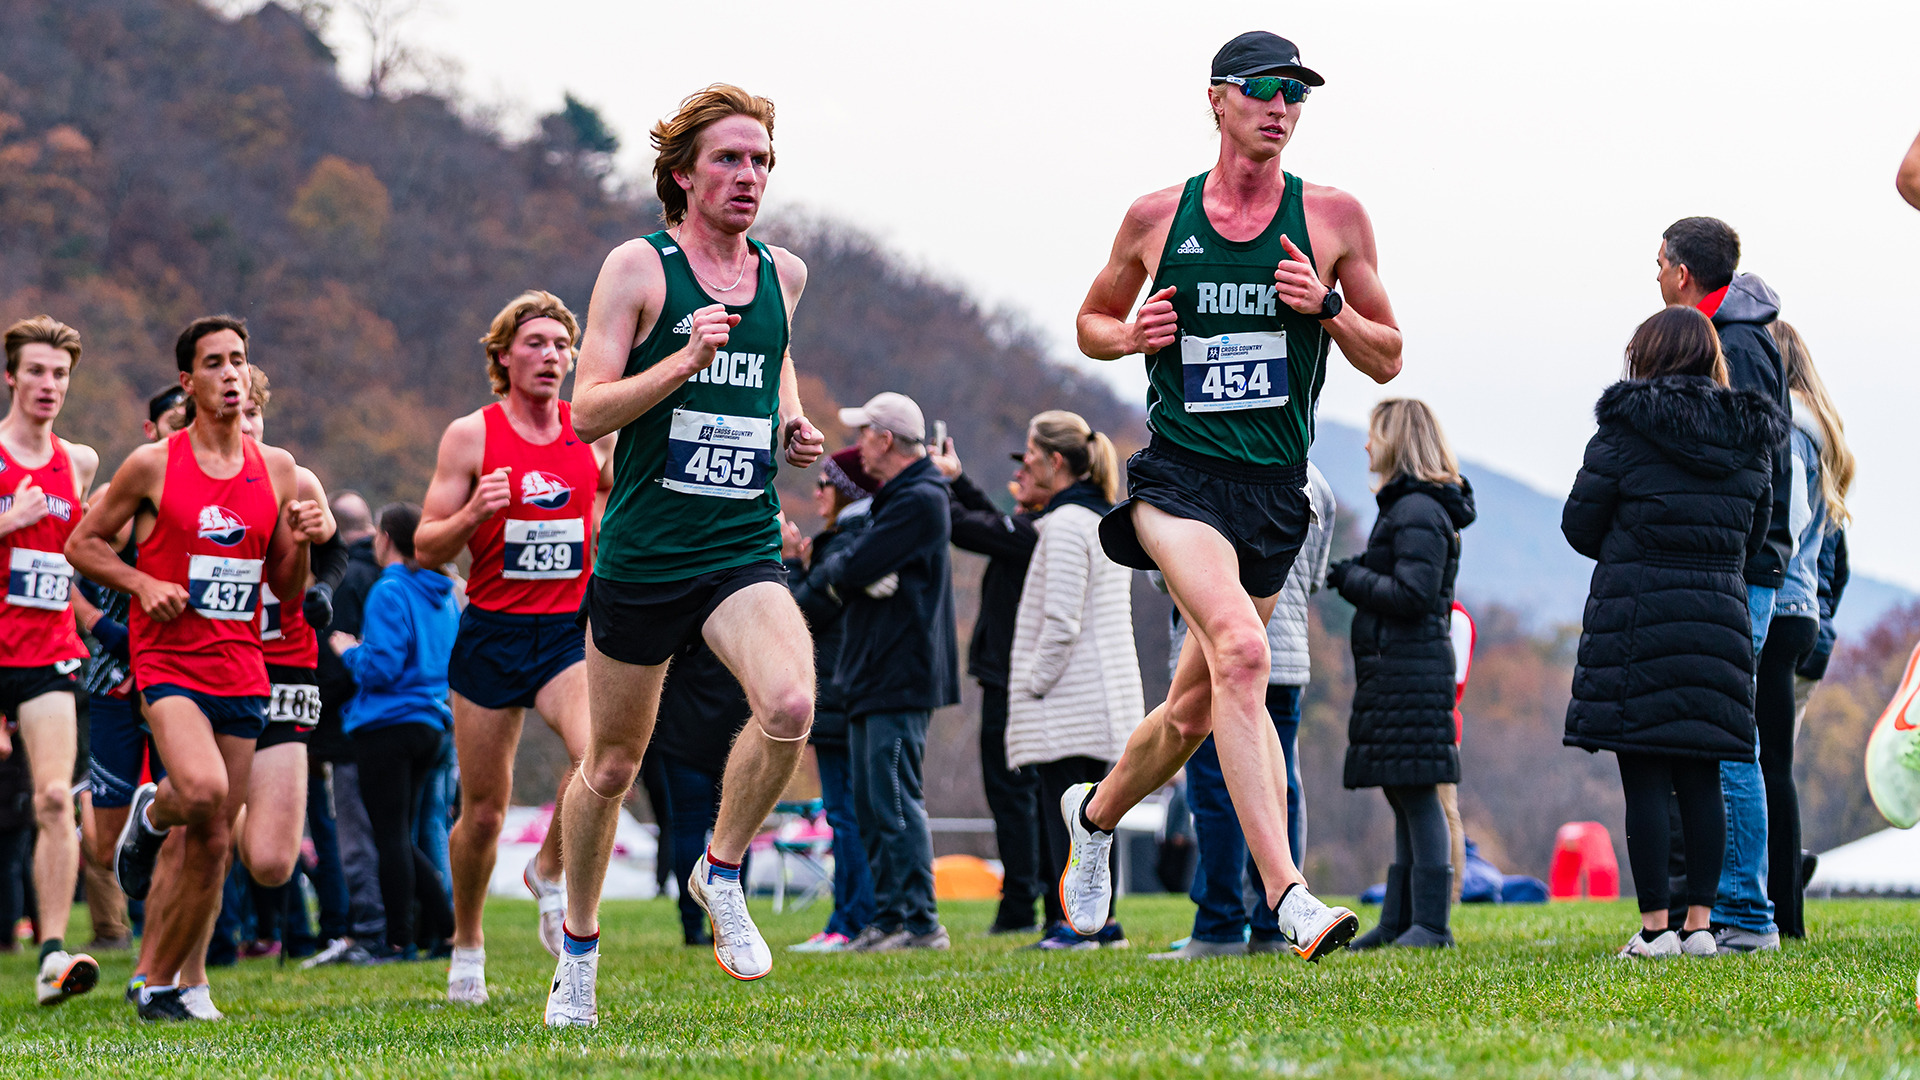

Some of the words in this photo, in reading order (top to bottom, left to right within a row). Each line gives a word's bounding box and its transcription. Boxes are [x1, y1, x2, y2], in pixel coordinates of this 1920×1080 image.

[1197, 282, 1278, 316] ROCK
[672, 325, 692, 334] adid
[1201, 362, 1271, 399] 454
[684, 446, 755, 486] 455
[518, 543, 572, 570] 439
[24, 572, 69, 601] 188
[202, 581, 253, 611] 437
